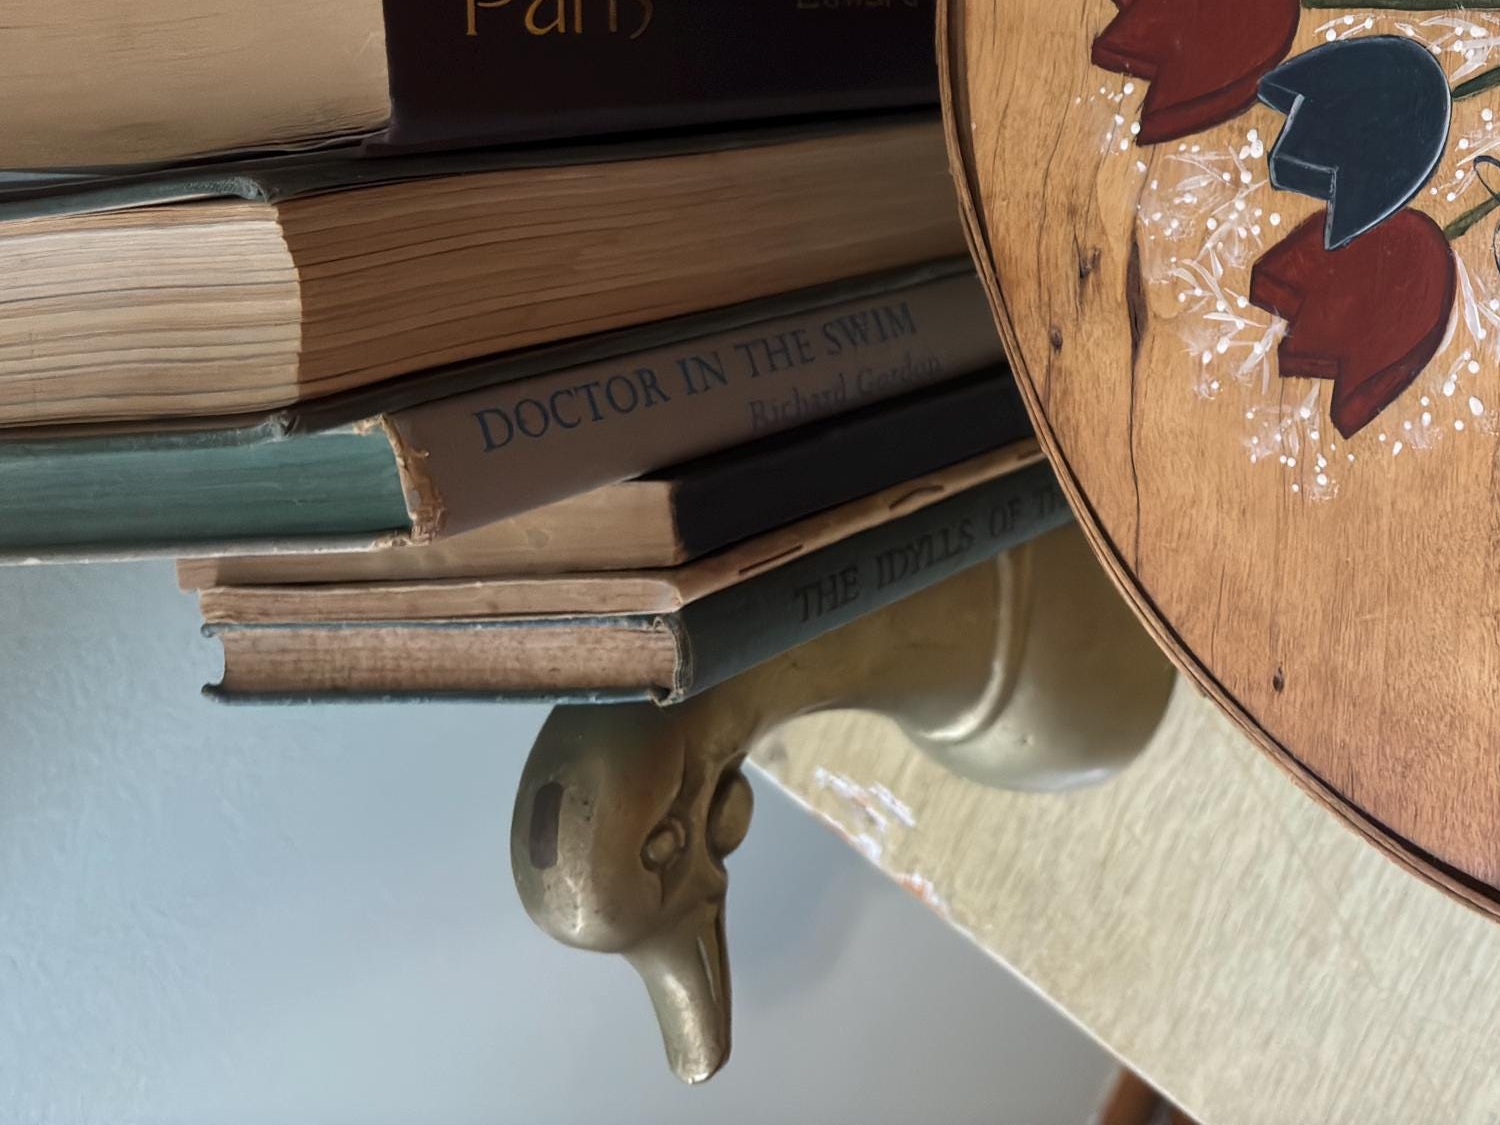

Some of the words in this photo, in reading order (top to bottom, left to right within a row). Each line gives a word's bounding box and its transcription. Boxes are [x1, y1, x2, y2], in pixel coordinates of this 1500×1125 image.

[473, 368, 668, 452] DOCTOR
[674, 351, 729, 396] IN
[735, 329, 816, 378] THE
[822, 302, 918, 356] SWIM
[749, 372, 847, 431] Richard
[795, 566, 862, 624] THE
[876, 517, 977, 591] IDYLLS
[990, 496, 1022, 537] OF
